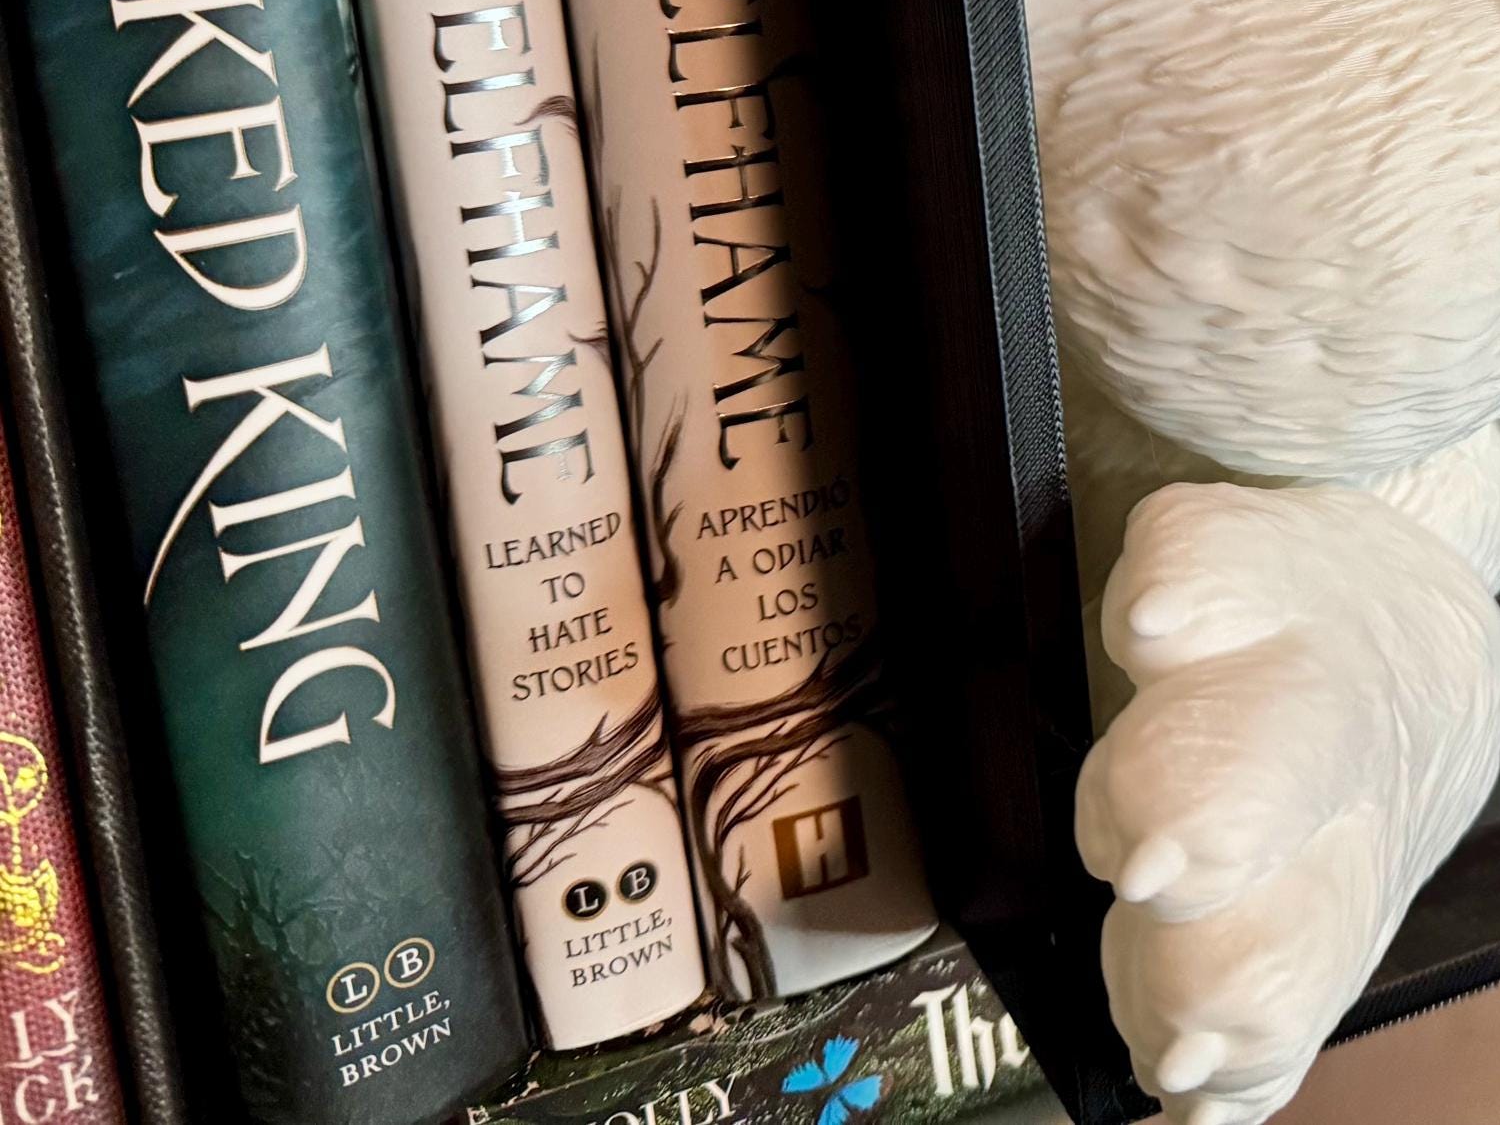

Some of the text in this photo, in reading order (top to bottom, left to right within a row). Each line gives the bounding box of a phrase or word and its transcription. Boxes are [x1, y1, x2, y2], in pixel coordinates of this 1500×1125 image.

[430, 0, 597, 506] ELFHAME
[143, 342, 396, 765] KING
[485, 512, 621, 568] LEARNED
[715, 527, 847, 584] A ODIAR
[540, 572, 585, 604] TO
[758, 583, 818, 621] LOS
[528, 607, 612, 653] HATE
[722, 614, 863, 672] CUENTOS
[511, 641, 638, 700] STORIES
[564, 908, 672, 959] LITTLE,
[571, 934, 673, 987] BROWN
[331, 991, 451, 1056] LITTLE,
[339, 1018, 451, 1087] BROWN
